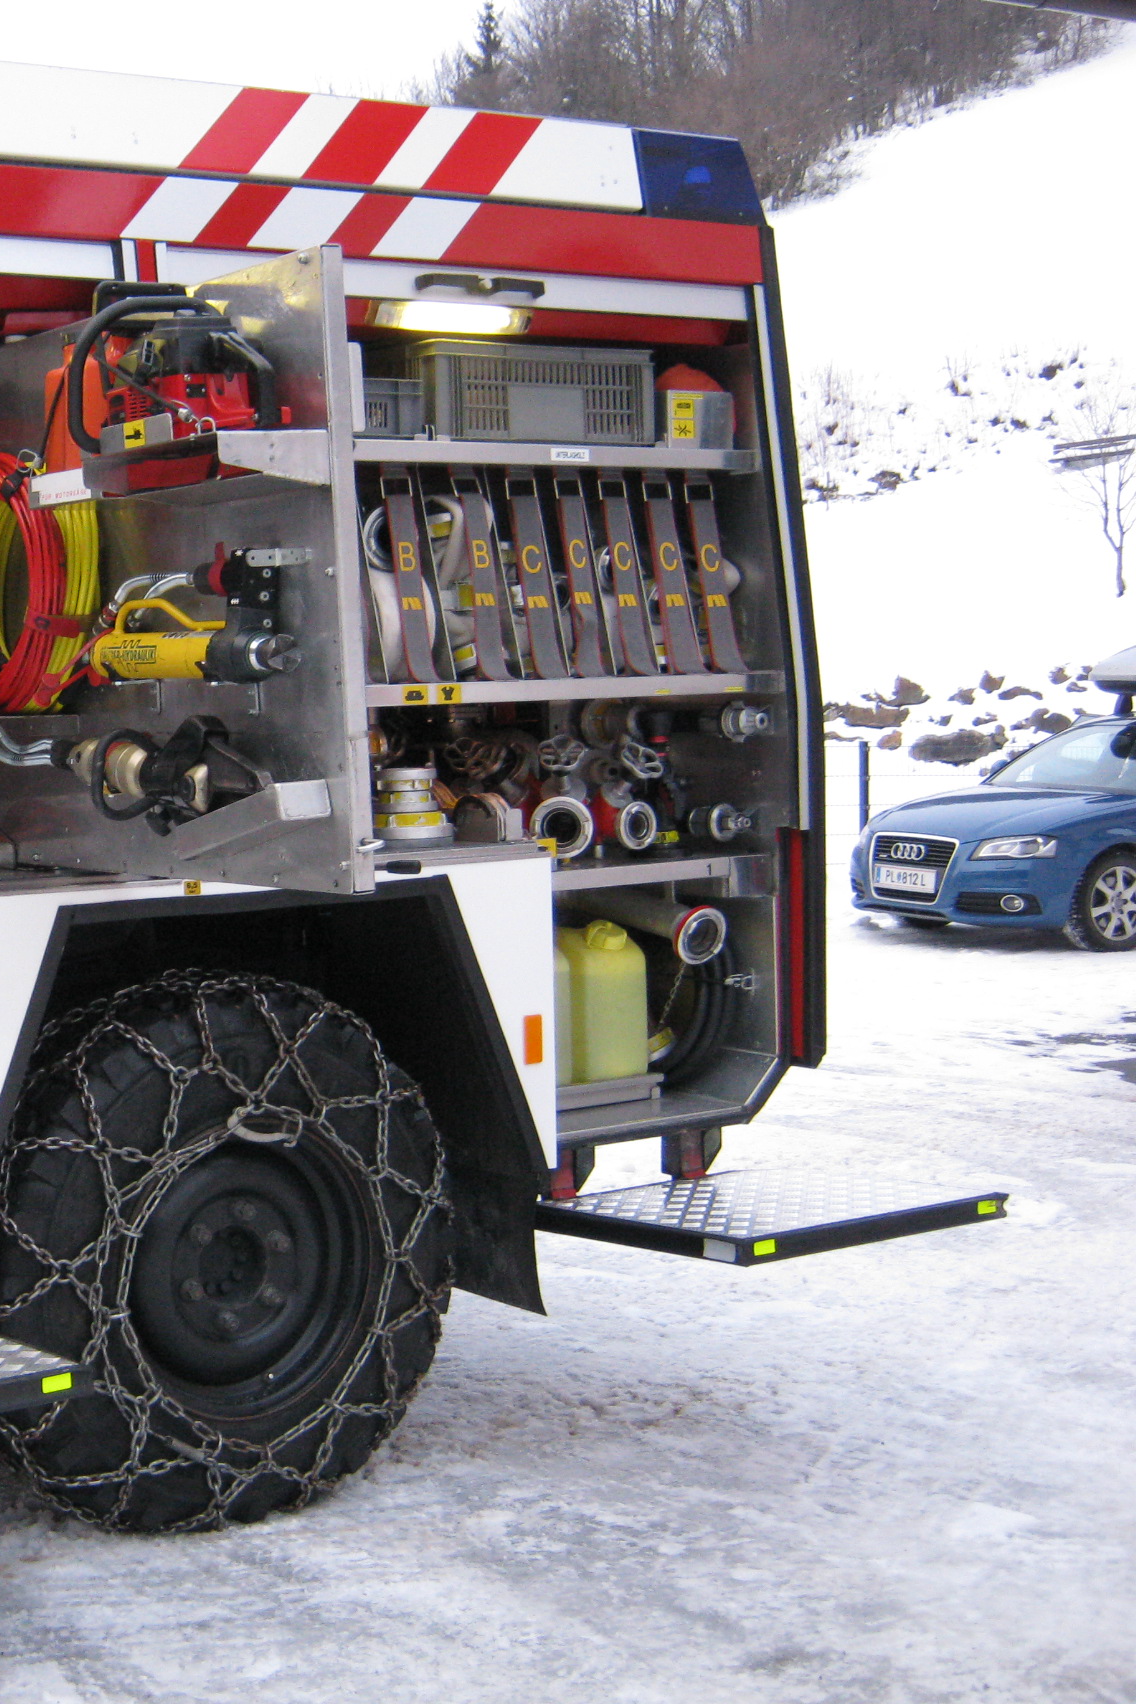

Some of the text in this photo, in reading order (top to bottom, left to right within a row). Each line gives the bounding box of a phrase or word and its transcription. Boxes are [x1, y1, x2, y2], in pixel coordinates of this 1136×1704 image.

[397, 541, 416, 571] B
[472, 539, 490, 568] B
[522, 545, 542, 574] C
[568, 539, 586, 568] C
[613, 541, 632, 571] C
[659, 541, 678, 571] C
[700, 543, 720, 572] C
